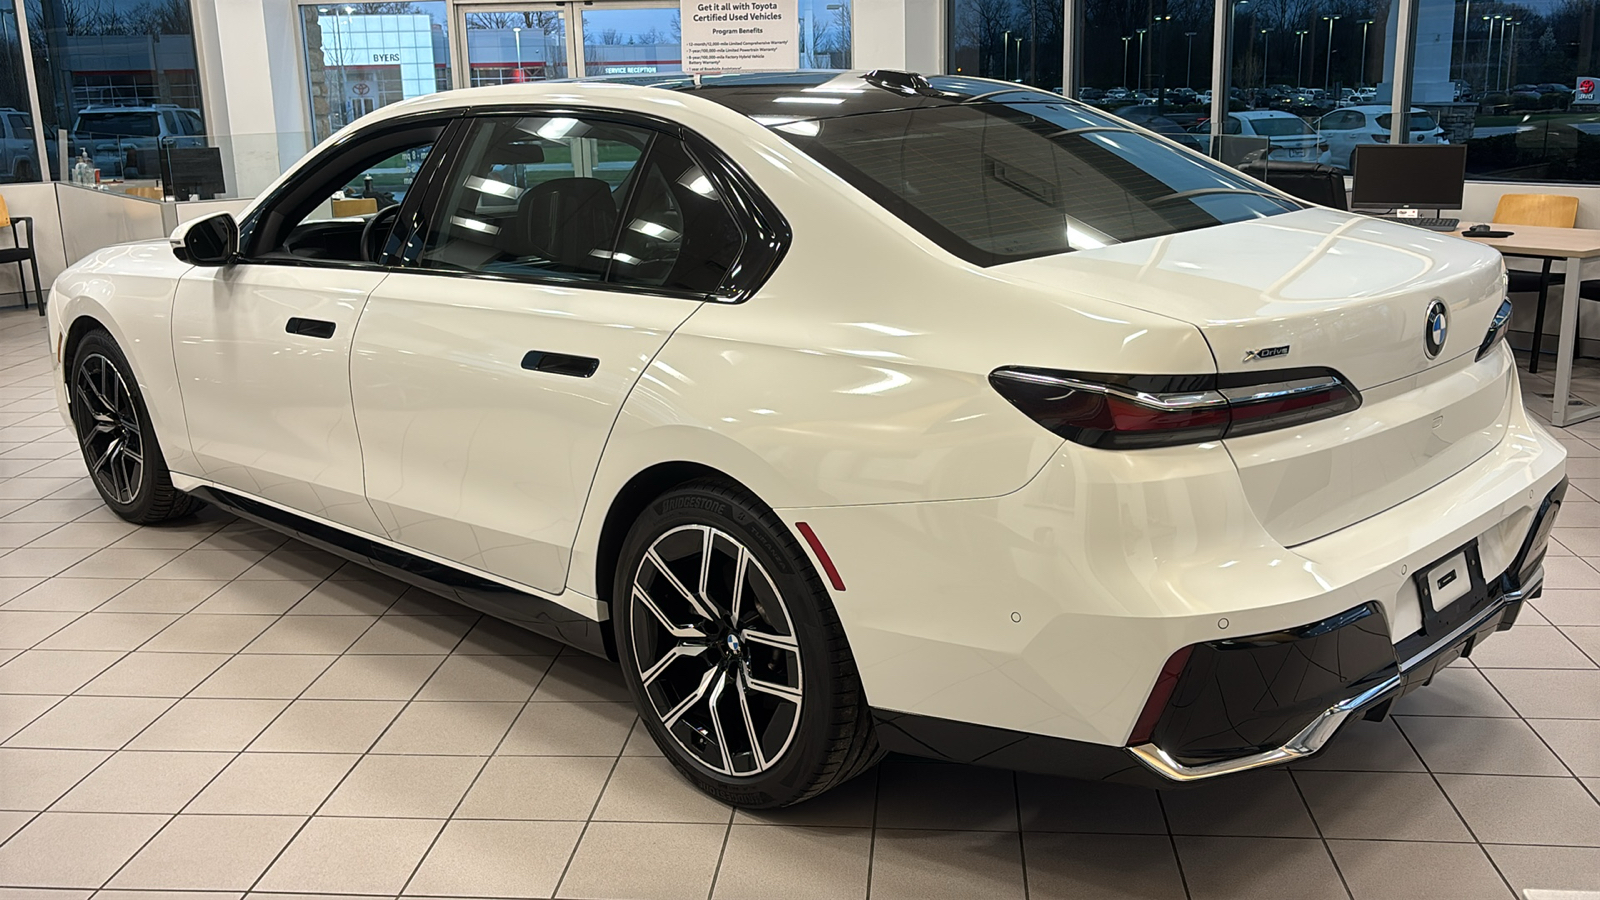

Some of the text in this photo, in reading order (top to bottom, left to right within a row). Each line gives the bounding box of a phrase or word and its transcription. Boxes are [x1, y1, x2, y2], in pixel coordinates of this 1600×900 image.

[698, 2, 778, 11] Get it all with Toyota
[693, 12, 782, 21] Certified Used Vehicles
[373, 53, 400, 62] BYERS
[662, 496, 725, 515] BRIDGESTONE
[751, 526, 787, 570] TURANZA
